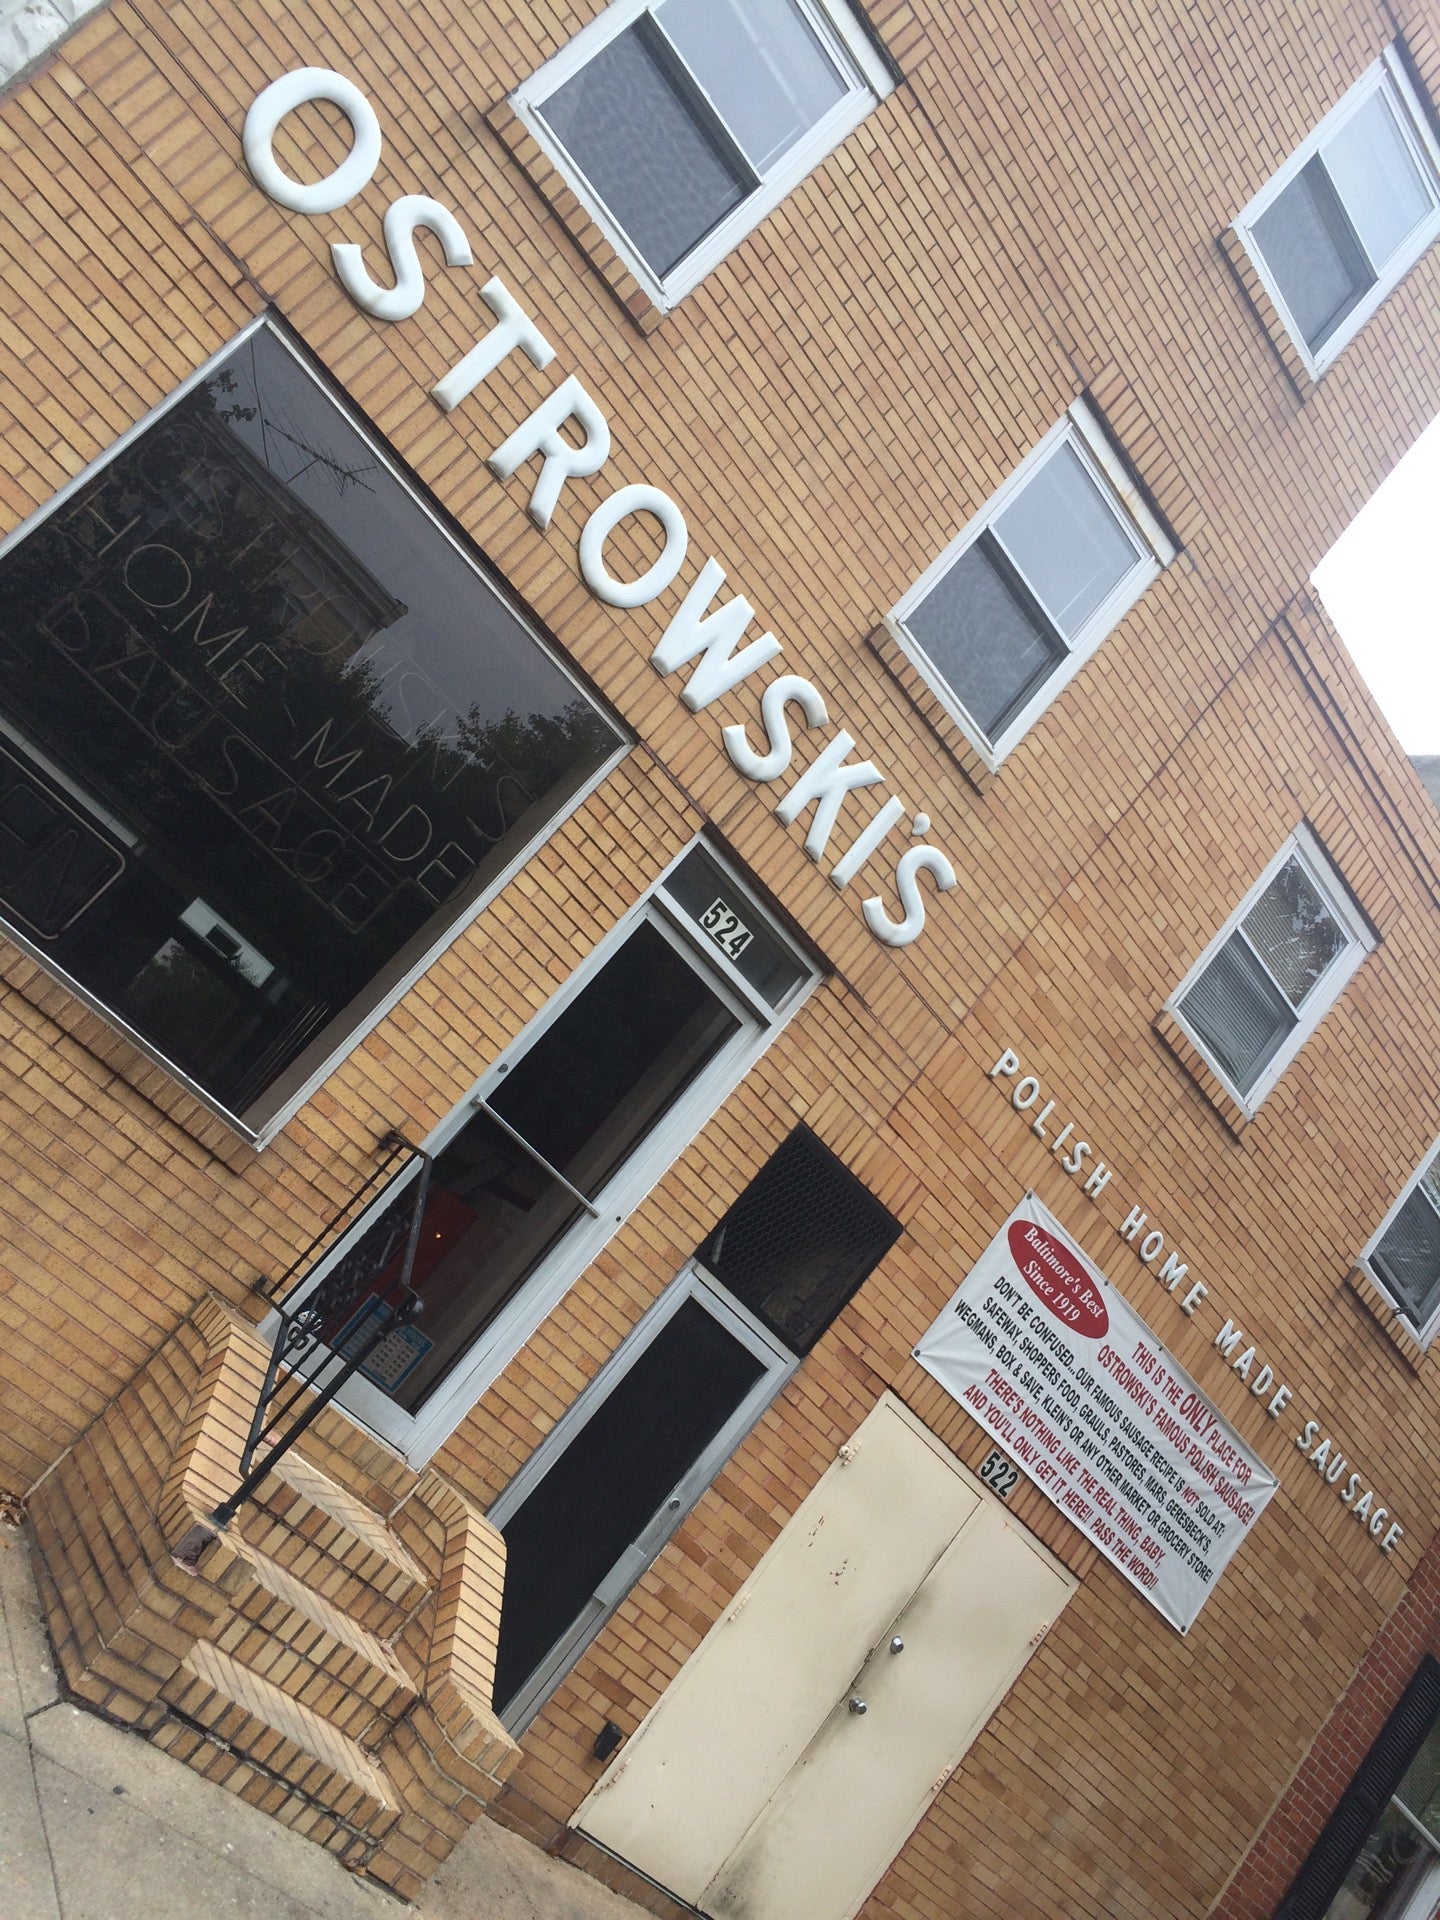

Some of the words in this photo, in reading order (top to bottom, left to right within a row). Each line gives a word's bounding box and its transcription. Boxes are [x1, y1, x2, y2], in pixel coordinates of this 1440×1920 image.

[243, 66, 957, 948] OSTROWSKI'S
[63, 484, 287, 708] HOME
[294, 718, 475, 905] MADE
[703, 901, 751, 956] 524
[989, 1047, 1113, 1199] POLISH
[1119, 1204, 1209, 1317] HOME
[1214, 1318, 1293, 1418] MADE
[1296, 1420, 1403, 1553] SAUSAGE
[1022, 1226, 1082, 1294] Baltimore's
[1078, 1288, 1105, 1318] Best
[1022, 1260, 1054, 1296] Since
[1052, 1292, 1081, 1321] 1919
[954, 1298, 998, 1355] WEGMANS,
[995, 1344, 1018, 1371] BOX
[1012, 1363, 1023, 1378] &
[1019, 1370, 1045, 1405] SAVE,
[1040, 1393, 1074, 1433] KLEIN'S
[1069, 1425, 1085, 1446] OR
[1079, 1437, 1101, 1461] ANY
[1095, 1454, 1124, 1488] OTHER
[1118, 1478, 1152, 1516] MARKET
[1146, 1509, 1162, 1529] OR
[1157, 1520, 1192, 1560] GROCERY
[962, 1383, 989, 1411] AND
[983, 1402, 1017, 1444] YOU'LL
[1012, 1435, 1042, 1466] ONLY
[1034, 1459, 1058, 1485] GET
[1051, 1476, 1068, 1495] IT
[1089, 1516, 1116, 1546] PASS
[1110, 1537, 1133, 1564] THE
[980, 1451, 1018, 1498] 522
[982, 1296, 1023, 1347] SAFEWAY,
[1018, 1336, 1062, 1386] SHOPPERS
[1056, 1378, 1081, 1414] FOOD,
[1078, 1403, 1111, 1446] GRAULS,
[1107, 1435, 1147, 1486] PASTORES,
[1143, 1475, 1168, 1509] MARS,
[1165, 1498, 1212, 1557] GERESBECK'S,
[984, 1367, 1025, 1415] THERE'S
[1018, 1406, 1062, 1455] NOTHING
[1055, 1446, 1082, 1476] LIKE
[1076, 1467, 1099, 1495] THE
[1092, 1485, 1118, 1517] REAL
[1113, 1506, 1143, 1547] THING,
[1139, 1534, 1167, 1569] BABY,
[993, 1275, 1023, 1308] DON'T
[1016, 1301, 1034, 1322] BE
[1089, 1384, 1123, 1423] FAMOUS
[1119, 1416, 1155, 1459] SAUSAGE
[1149, 1449, 1179, 1485] RECIPE
[1173, 1476, 1186, 1493] IS
[1180, 1485, 1201, 1508] NOT
[1194, 1500, 1216, 1527] SOLD
[1097, 1344, 1158, 1417] OSTROWSKI'S
[1152, 1406, 1191, 1454] FAMOUS
[1184, 1443, 1221, 1487] POLISH
[1131, 1340, 1157, 1375] THIS
[1150, 1364, 1167, 1386] IS
[1161, 1375, 1184, 1407] THE
[1179, 1392, 1219, 1438] ONLY
[1205, 1420, 1241, 1469] PLACE
[1231, 1456, 1253, 1488] FOR
